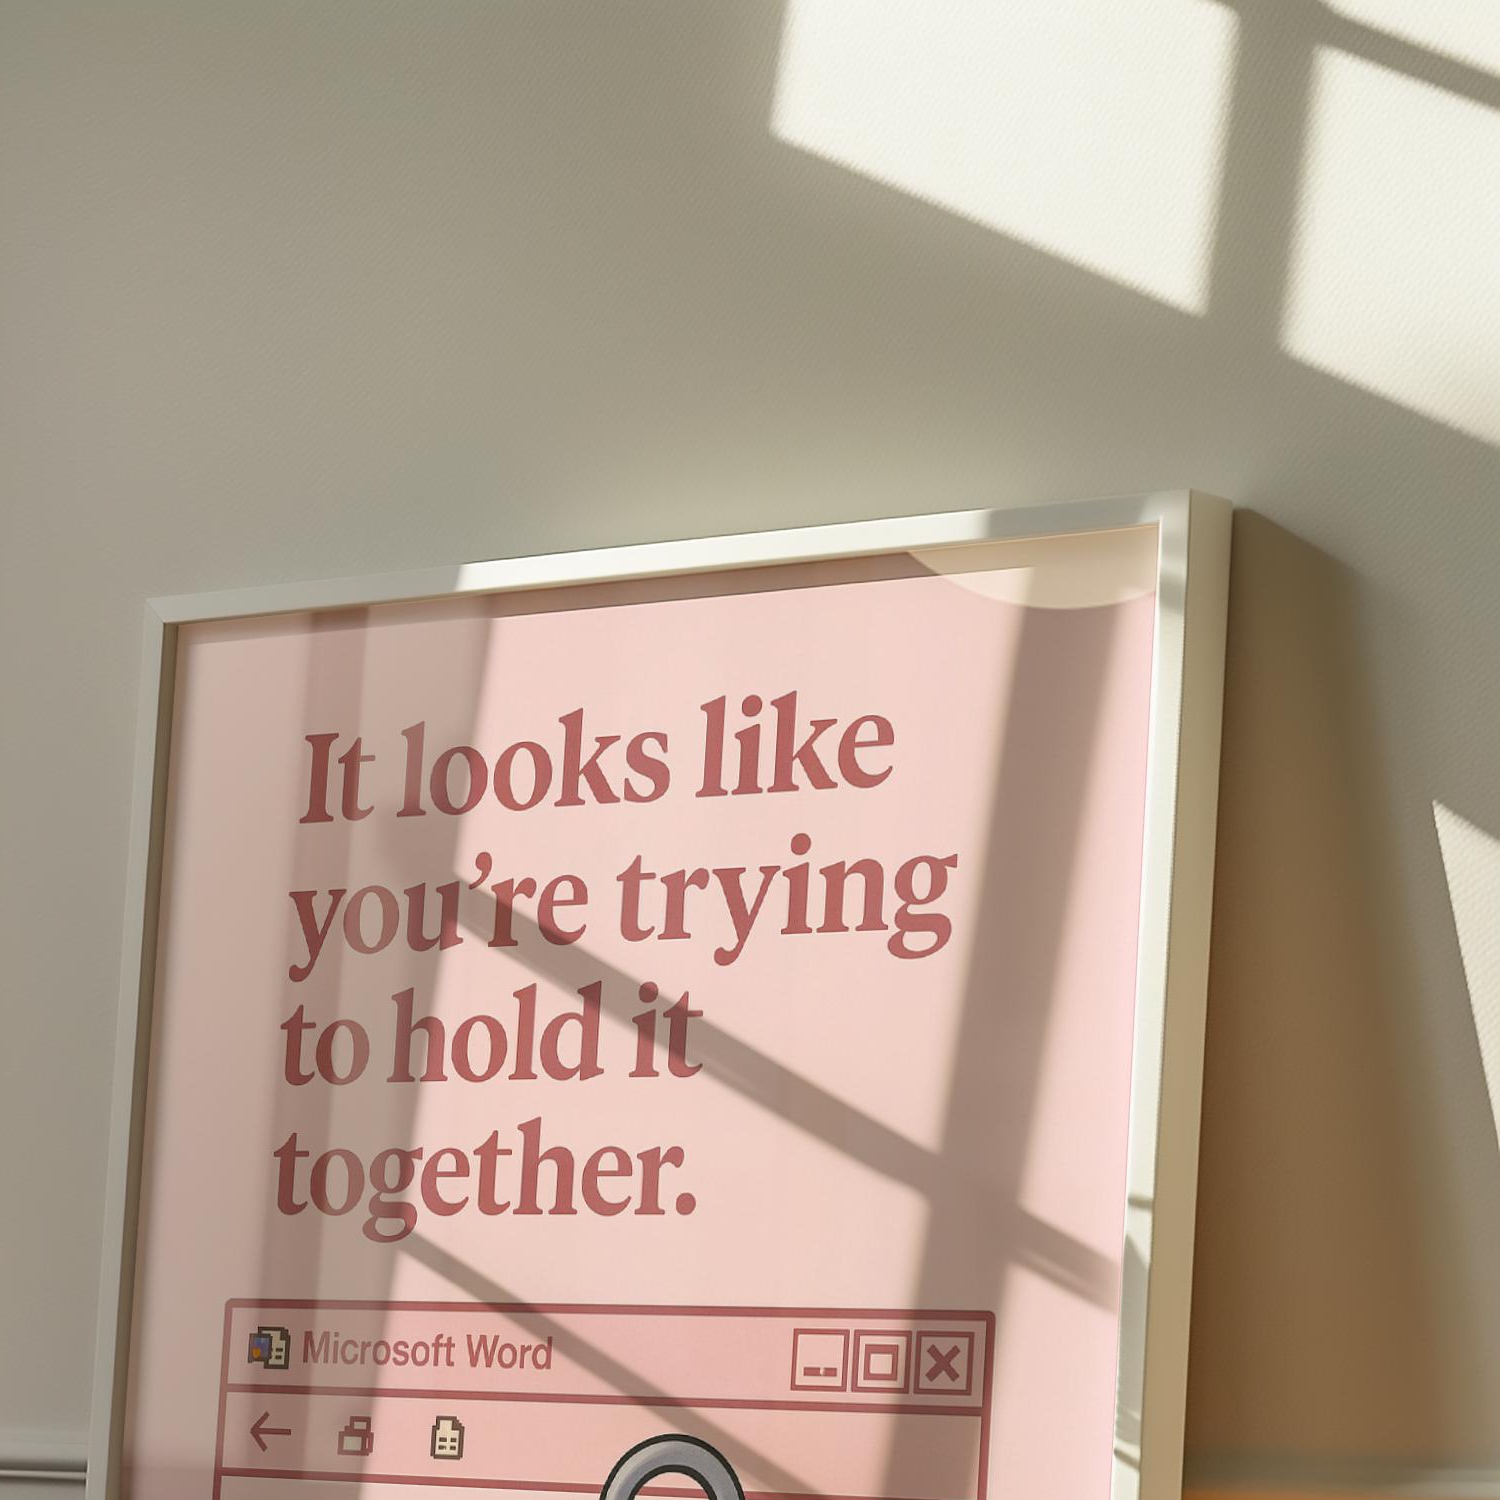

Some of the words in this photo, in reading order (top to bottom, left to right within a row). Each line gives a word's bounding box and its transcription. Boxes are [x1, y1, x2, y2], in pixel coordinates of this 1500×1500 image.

[299, 732, 376, 824] It
[396, 708, 671, 819] looks
[695, 690, 895, 798] like
[288, 852, 589, 983] you’re
[616, 832, 958, 967] trying
[280, 1004, 370, 1086] to
[386, 980, 605, 1083] hold
[628, 981, 704, 1079] it
[273, 1116, 697, 1244] together.
[302, 1330, 455, 1368] Microsoft
[466, 1333, 553, 1370] Word
